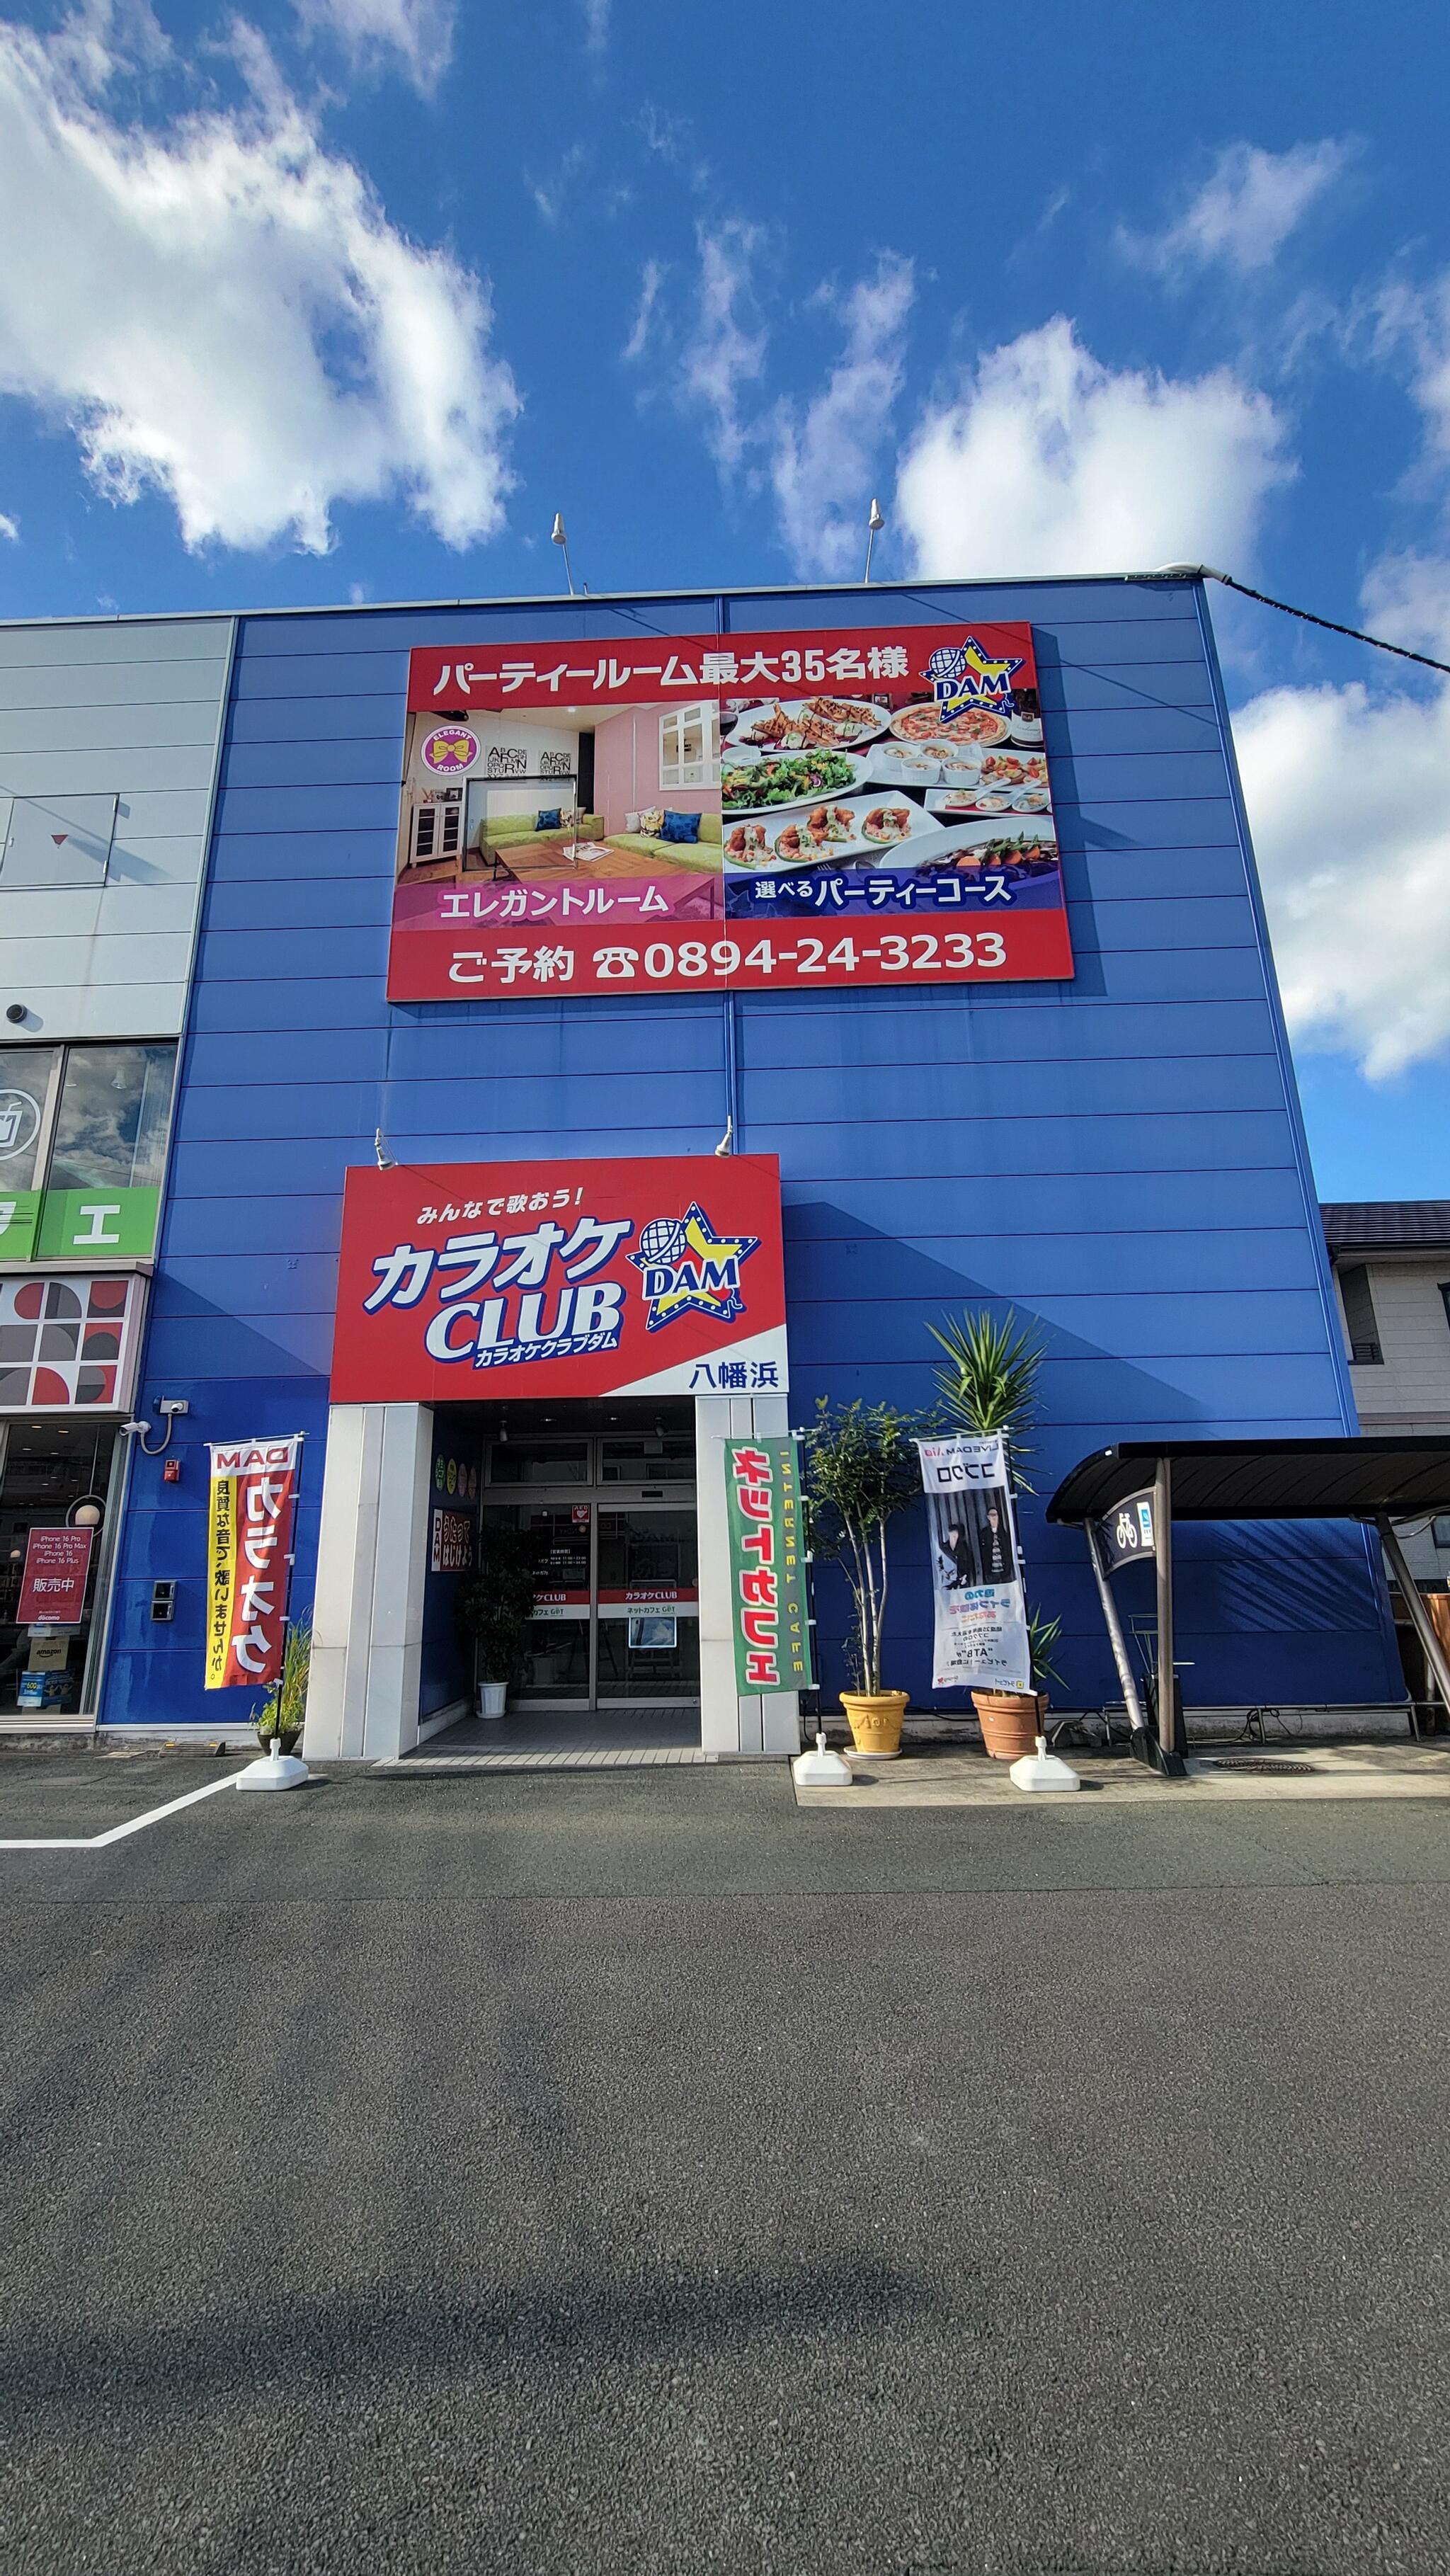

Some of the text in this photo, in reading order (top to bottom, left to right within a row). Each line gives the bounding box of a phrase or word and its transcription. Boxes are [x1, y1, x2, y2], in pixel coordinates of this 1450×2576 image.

[433, 646, 908, 695] パーティールーム最大35名様
[935, 670, 1012, 702] DAM
[433, 729, 472, 741] ELEGANT
[437, 763, 464, 772] ROOM
[440, 888, 670, 918] エレガントルーム
[447, 933, 1007, 982] ご予約 0894-24-3233
[365, 1218, 632, 1310] カラオケ
[644, 1257, 739, 1299] DAM
[426, 1282, 621, 1360] CLUB
[475, 1332, 617, 1368] カラオケクラブダム
[689, 1362, 778, 1389] 八幡浜
[33, 1578, 74, 1592] 販売中
[625, 1591, 678, 1600] カラオケCLUB
